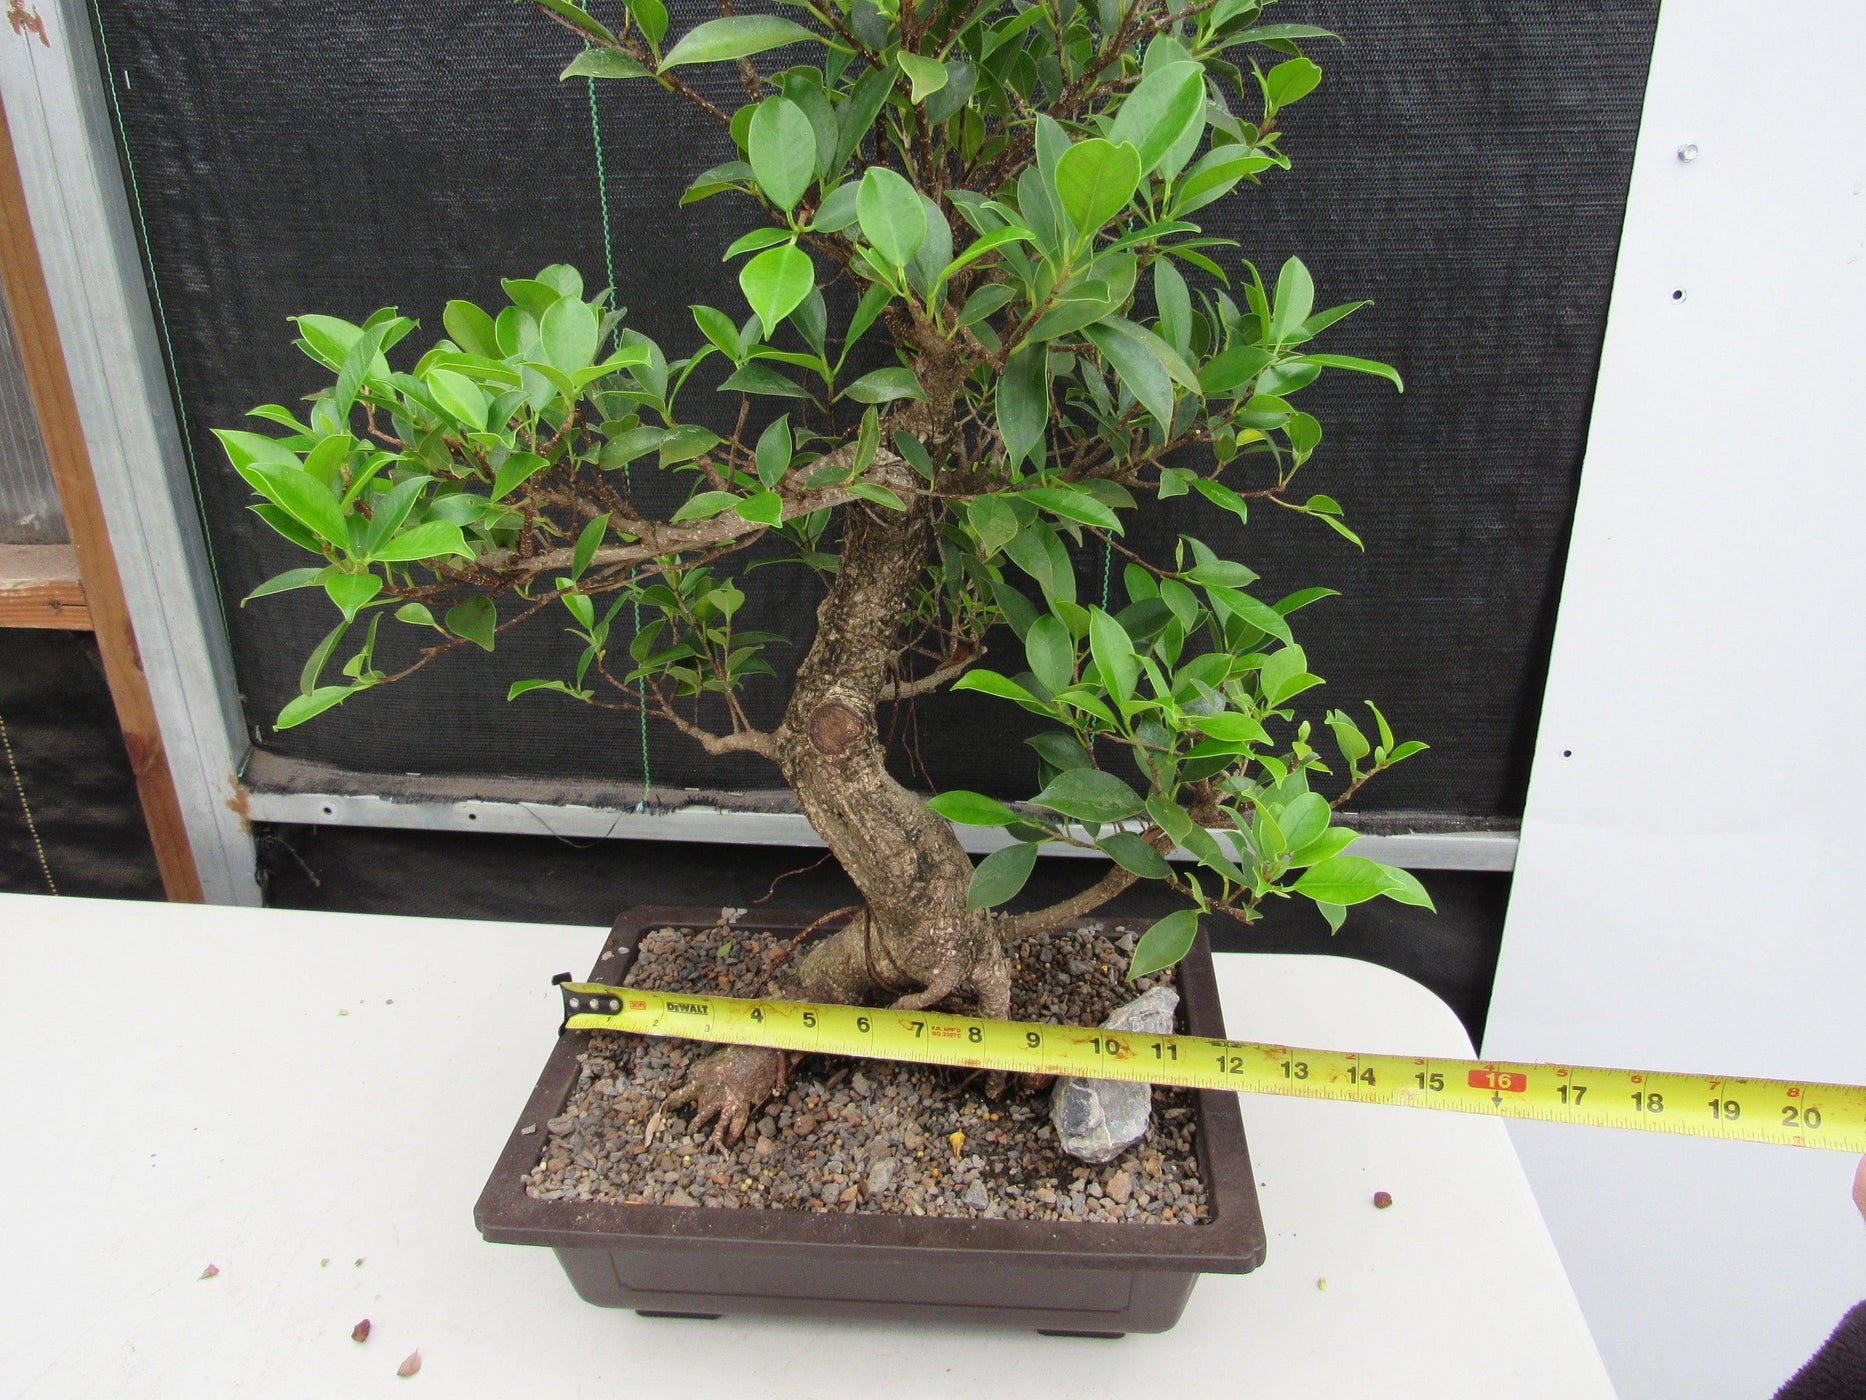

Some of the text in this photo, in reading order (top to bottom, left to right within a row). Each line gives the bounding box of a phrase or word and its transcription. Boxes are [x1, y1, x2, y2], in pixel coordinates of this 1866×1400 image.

[653, 1019, 659, 1027] 2
[704, 1024, 711, 1032] 3
[750, 1007, 764, 1024] 4
[803, 1012, 817, 1028] 5
[856, 1017, 871, 1033] 6
[911, 1021, 925, 1038] 7
[968, 1027, 983, 1043] 8
[1025, 1032, 1041, 1048] 9
[1090, 1037, 1120, 1055] 10
[1151, 1043, 1177, 1060] 11
[1216, 1055, 1244, 1074] 12
[1280, 1060, 1309, 1079] 13
[1346, 1066, 1376, 1085] 14
[1414, 1072, 1445, 1091] 15
[1485, 1072, 1512, 1089] 16
[1556, 1084, 1588, 1105] 17
[1631, 1091, 1664, 1113] 18
[1708, 1099, 1741, 1121] 19
[1781, 1105, 1822, 1129] 20
[1414, 1058, 1425, 1066] 3
[1556, 1069, 1569, 1077] 5
[1631, 1075, 1643, 1084] 6
[1708, 1081, 1721, 1090] 7
[1786, 1087, 1800, 1098] 8
